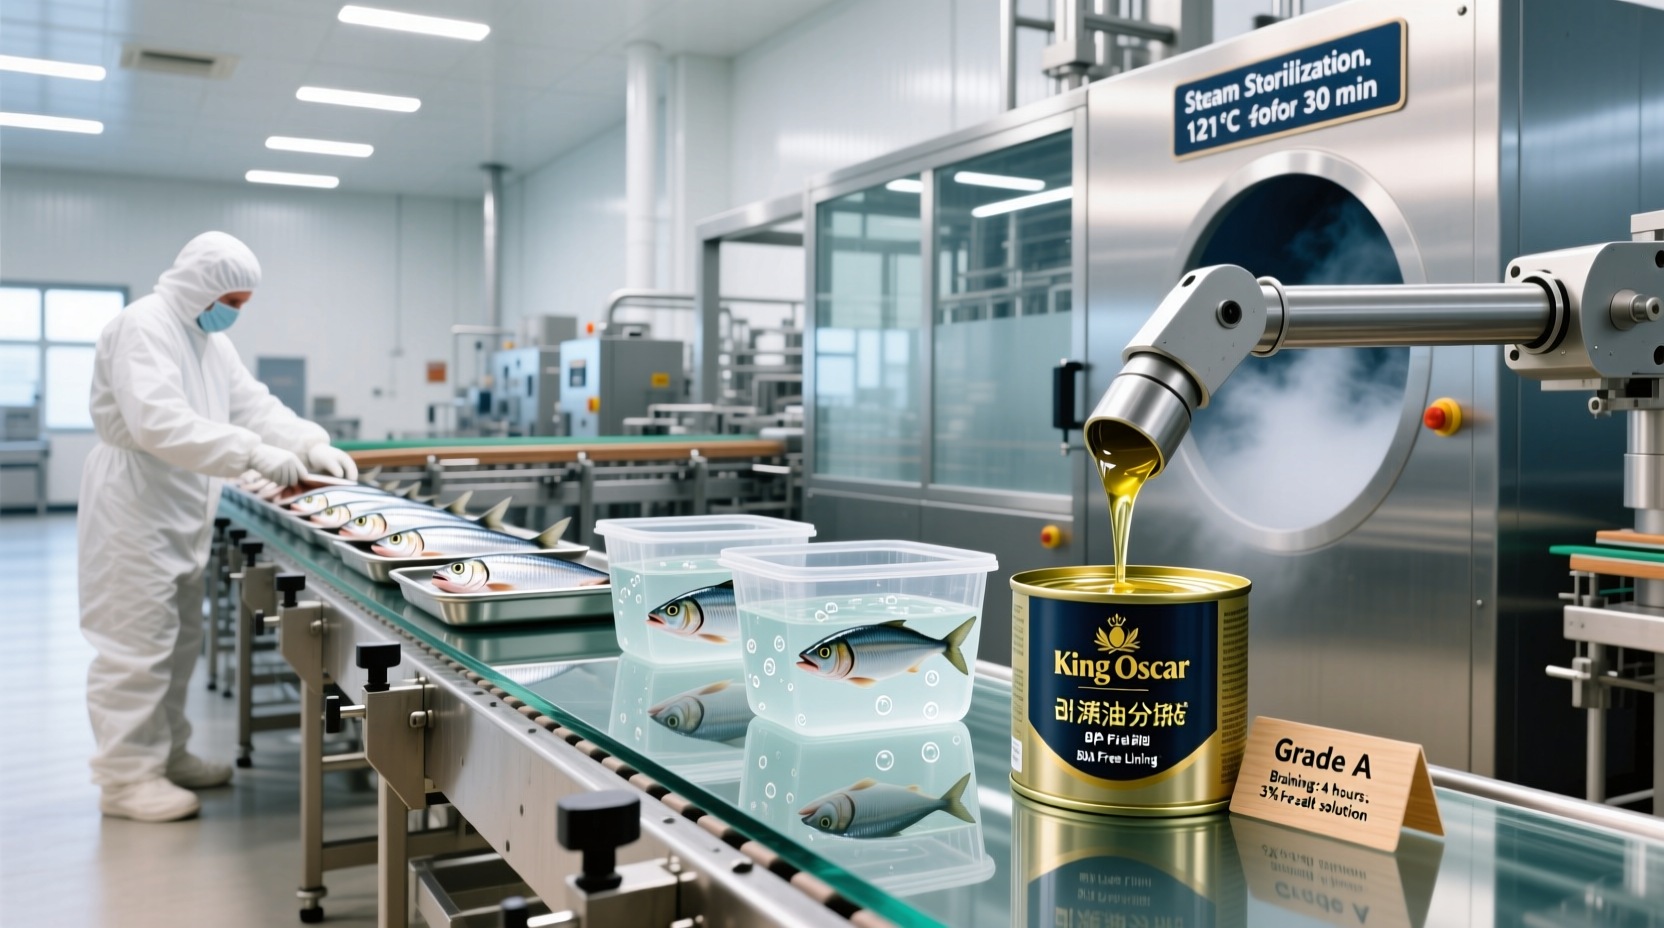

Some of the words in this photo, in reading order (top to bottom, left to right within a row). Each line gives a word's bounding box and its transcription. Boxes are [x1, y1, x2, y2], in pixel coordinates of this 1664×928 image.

[1184, 83, 1240, 114] Steam
[1303, 86, 1331, 115] 30
[1335, 76, 1378, 106] min
[1054, 650, 1111, 686] King
[1114, 654, 1190, 680] Oscar
[1274, 738, 1346, 773] Grade
[1351, 753, 1372, 779] A
[1321, 782, 1329, 794] 4
[1318, 800, 1368, 822] solution
